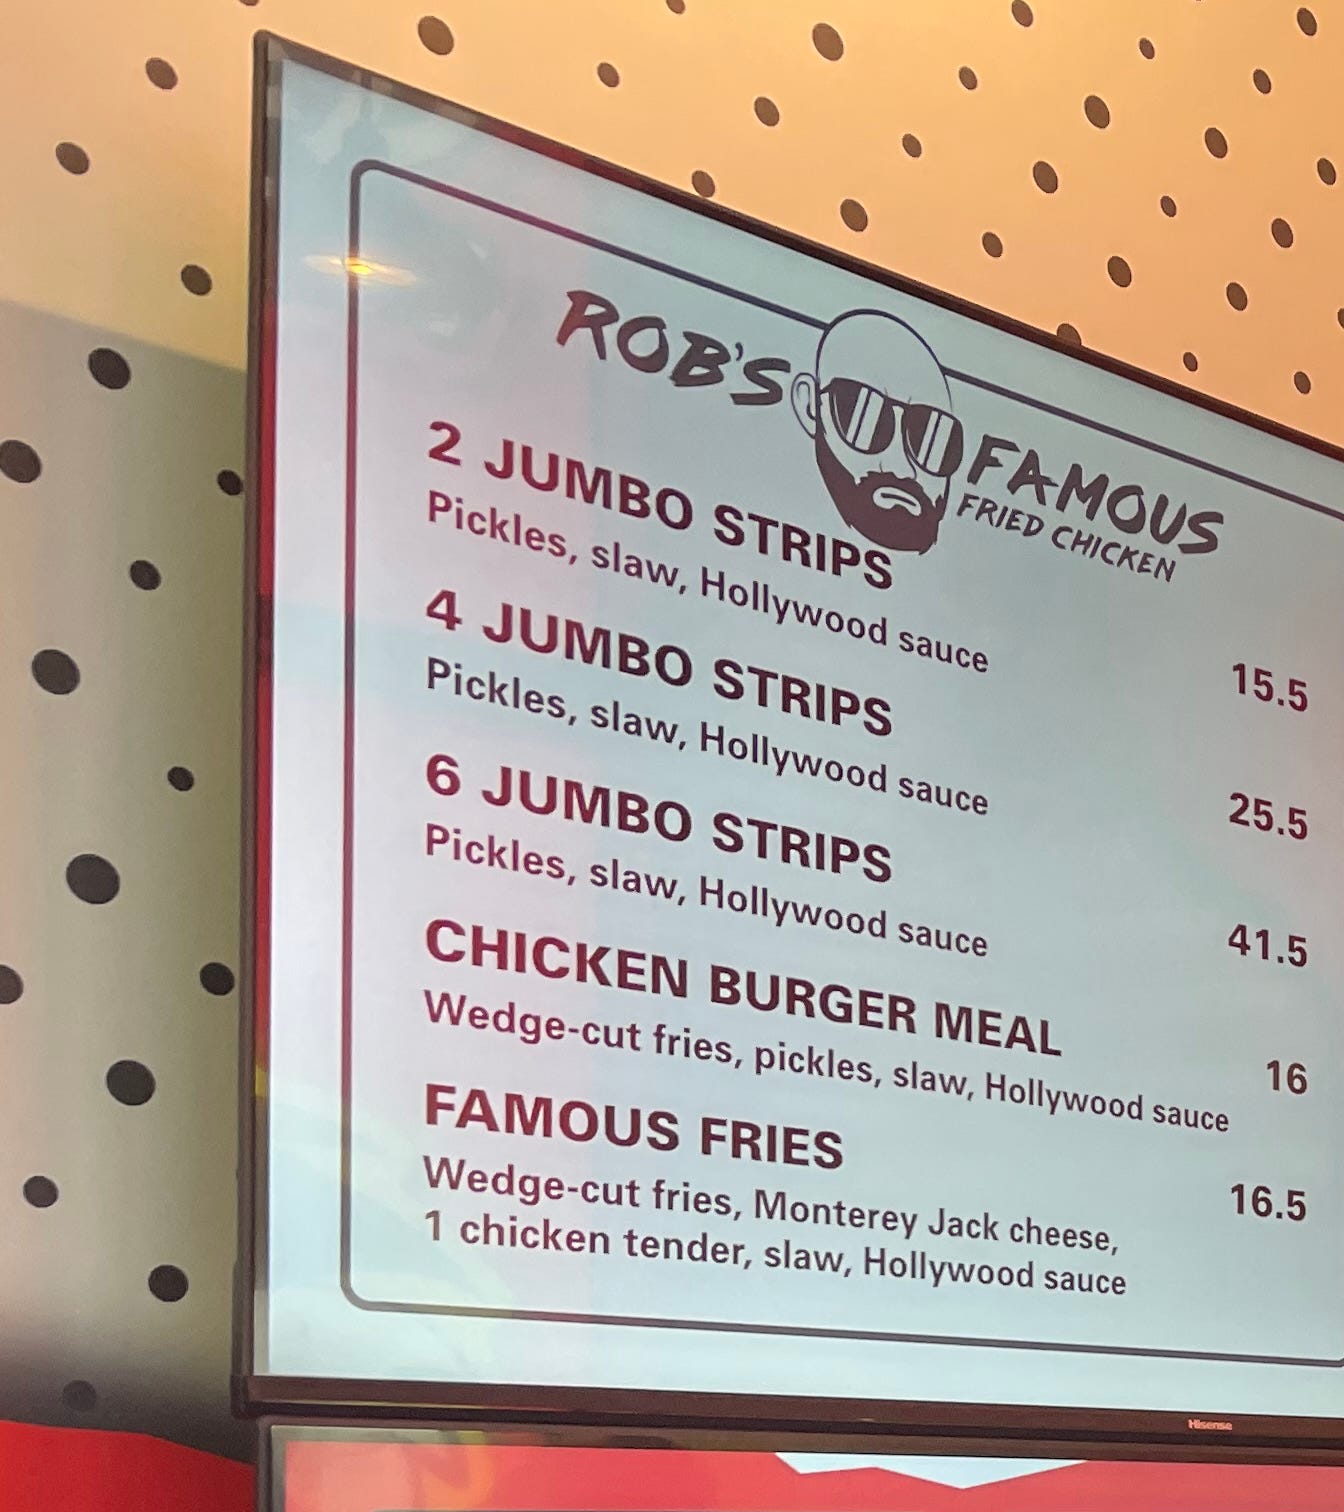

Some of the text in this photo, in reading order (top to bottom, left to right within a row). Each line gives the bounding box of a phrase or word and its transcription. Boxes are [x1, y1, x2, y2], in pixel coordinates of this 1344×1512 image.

[555, 290, 791, 406] ROB'S
[429, 422, 892, 589] 2 JUMBO STRIPS
[956, 492, 1177, 584] FRIED CHICKEN
[966, 434, 1224, 555] FAMOUS
[429, 490, 988, 672] Pickles, slaw, Hollywood sauce
[426, 590, 892, 736] 4 JUMBO STRIPS
[1233, 663, 1307, 712] 15.5
[426, 754, 891, 883] 6 JUMBO STRIPS
[1229, 793, 1307, 840] 25.5
[426, 920, 1061, 1056] CHICKEN BURGER MEAL
[1228, 924, 1307, 967] 41.5
[424, 990, 1228, 1132] Wedge-cut fries, pickles, slaw, Hollywood sauce
[1267, 1060, 1307, 1094] 16
[427, 1084, 843, 1169] FAMOUS FRIES
[423, 1156, 1117, 1255] Wedge-cut fries, Monterey Jack cheese,
[1231, 1184, 1306, 1221] 16.5
[426, 1210, 1126, 1295] 1 chicken tender, slaw, Hollywood sauce
